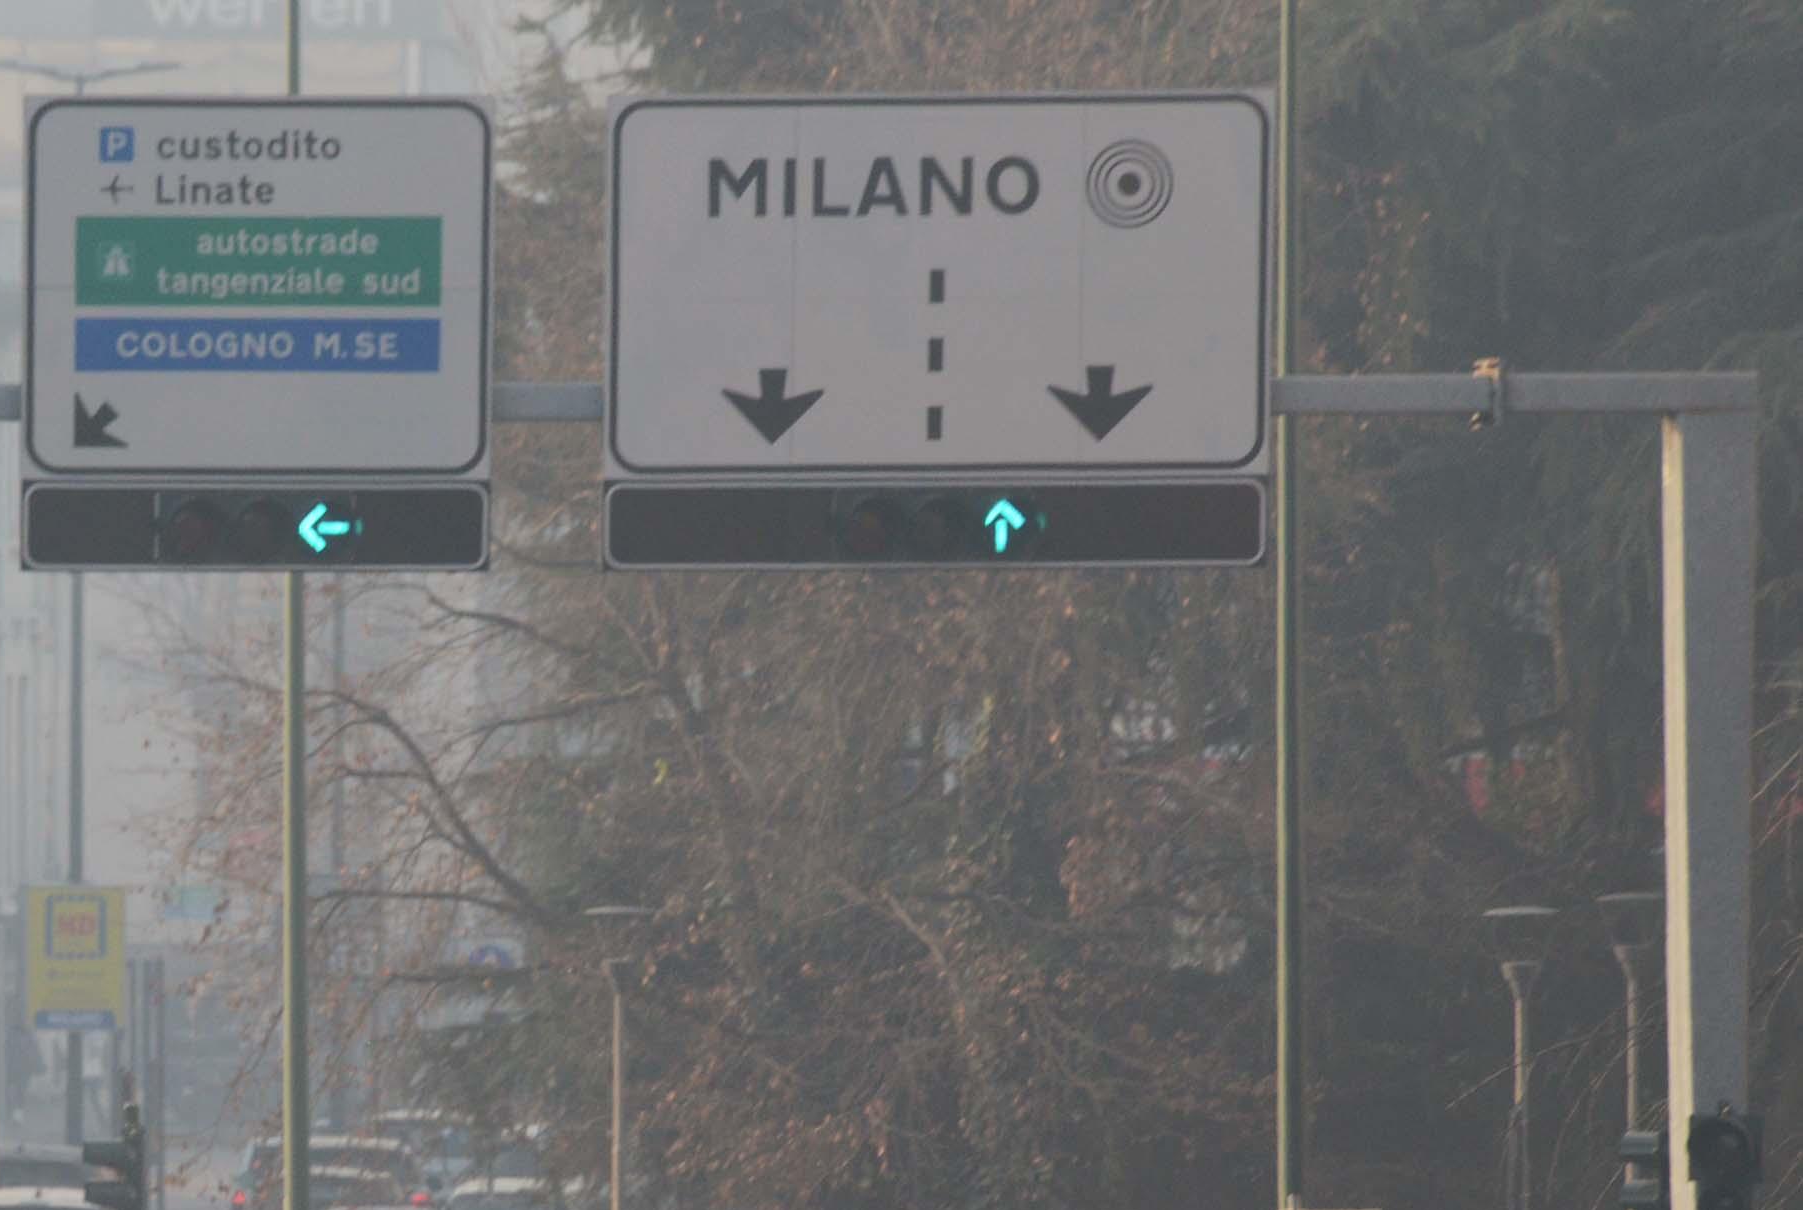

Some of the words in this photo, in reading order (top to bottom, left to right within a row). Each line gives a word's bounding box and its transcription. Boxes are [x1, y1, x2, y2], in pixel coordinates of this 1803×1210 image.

[150, 0, 392, 28] weren
[157, 129, 342, 161] custodito
[154, 174, 276, 205] Linate
[707, 155, 1041, 217] MILANO
[197, 228, 380, 256] autostrade
[157, 267, 344, 298] tangenziale
[363, 268, 421, 295] sud
[116, 331, 295, 359] COLOGNO
